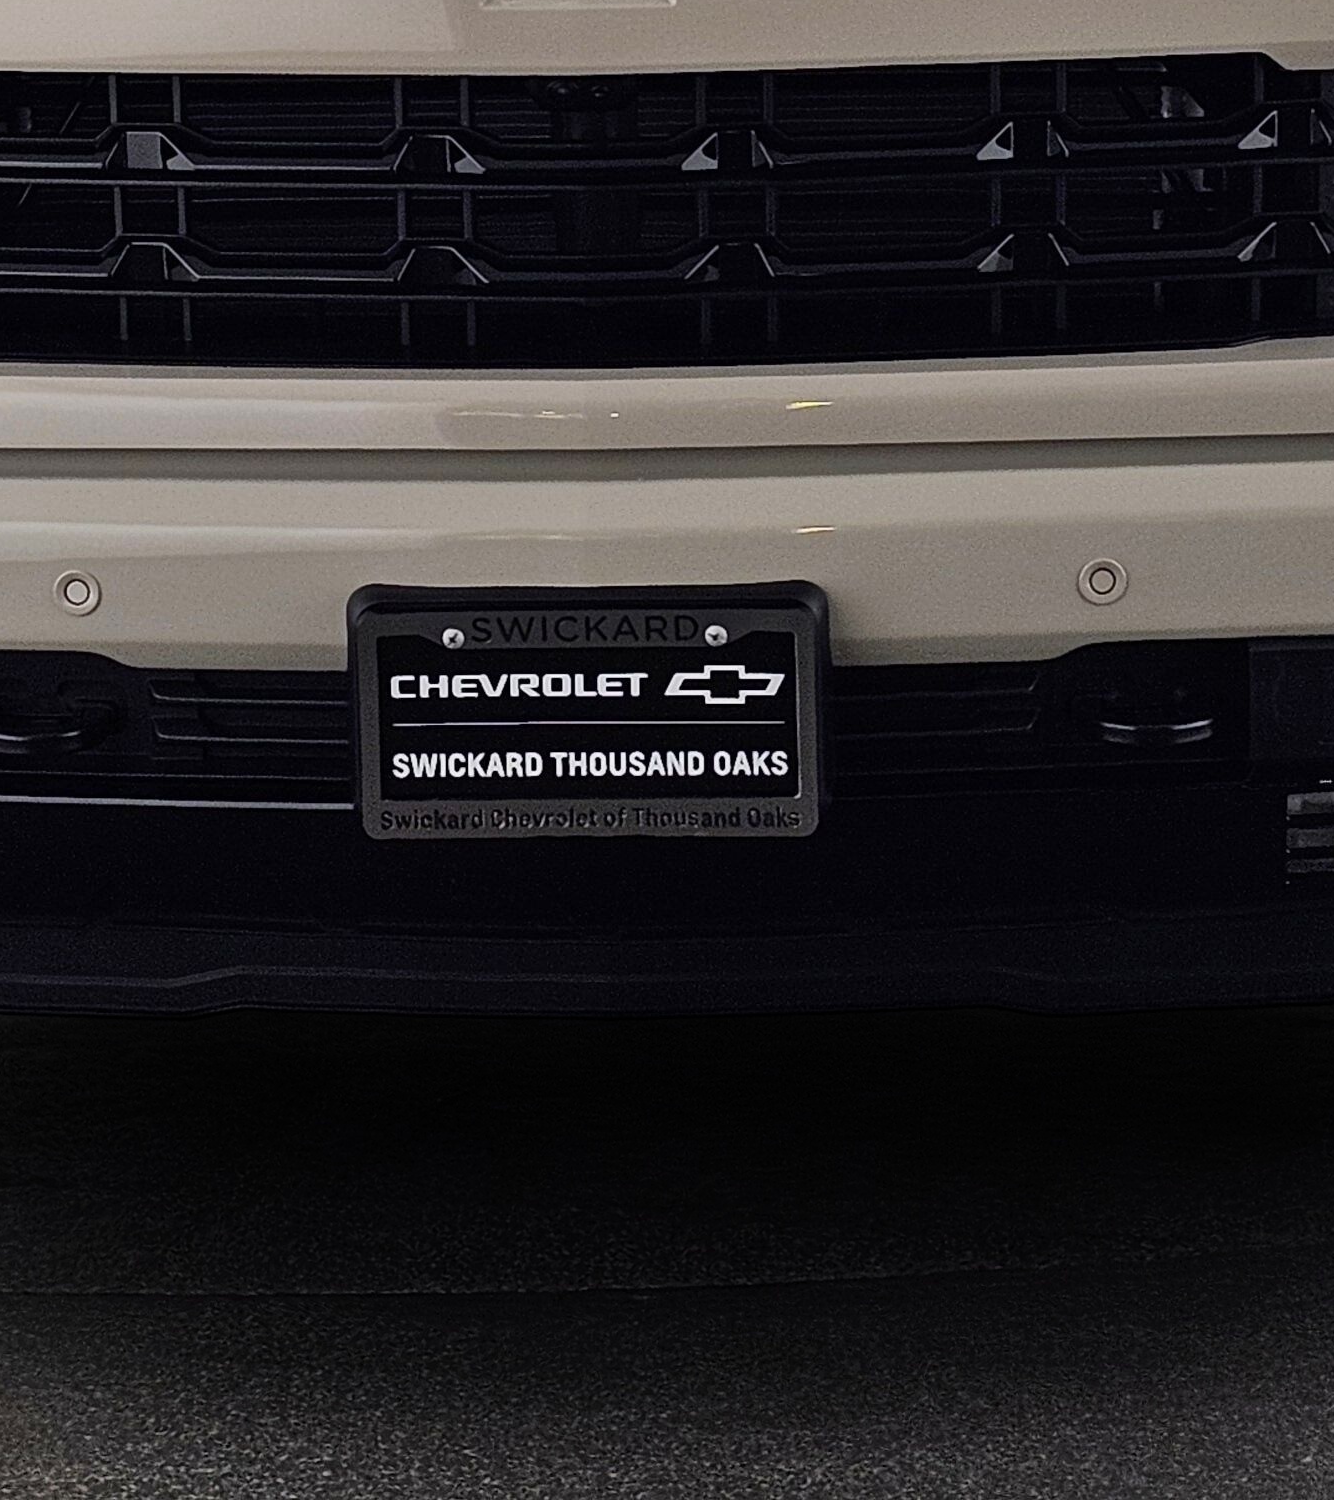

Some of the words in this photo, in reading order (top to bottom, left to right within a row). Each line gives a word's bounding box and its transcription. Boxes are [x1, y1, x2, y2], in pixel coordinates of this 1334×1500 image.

[471, 615, 700, 644] SWICKARD
[390, 673, 649, 699] CHEVROLET
[392, 752, 543, 778] SWICKARD
[549, 751, 706, 777] THOUSAND
[712, 750, 789, 776] OAKS
[380, 811, 483, 830] Swickard
[490, 809, 597, 829] Chevrolet
[602, 808, 627, 827] of
[633, 806, 740, 828] Thousand
[746, 806, 801, 828] Oaks
